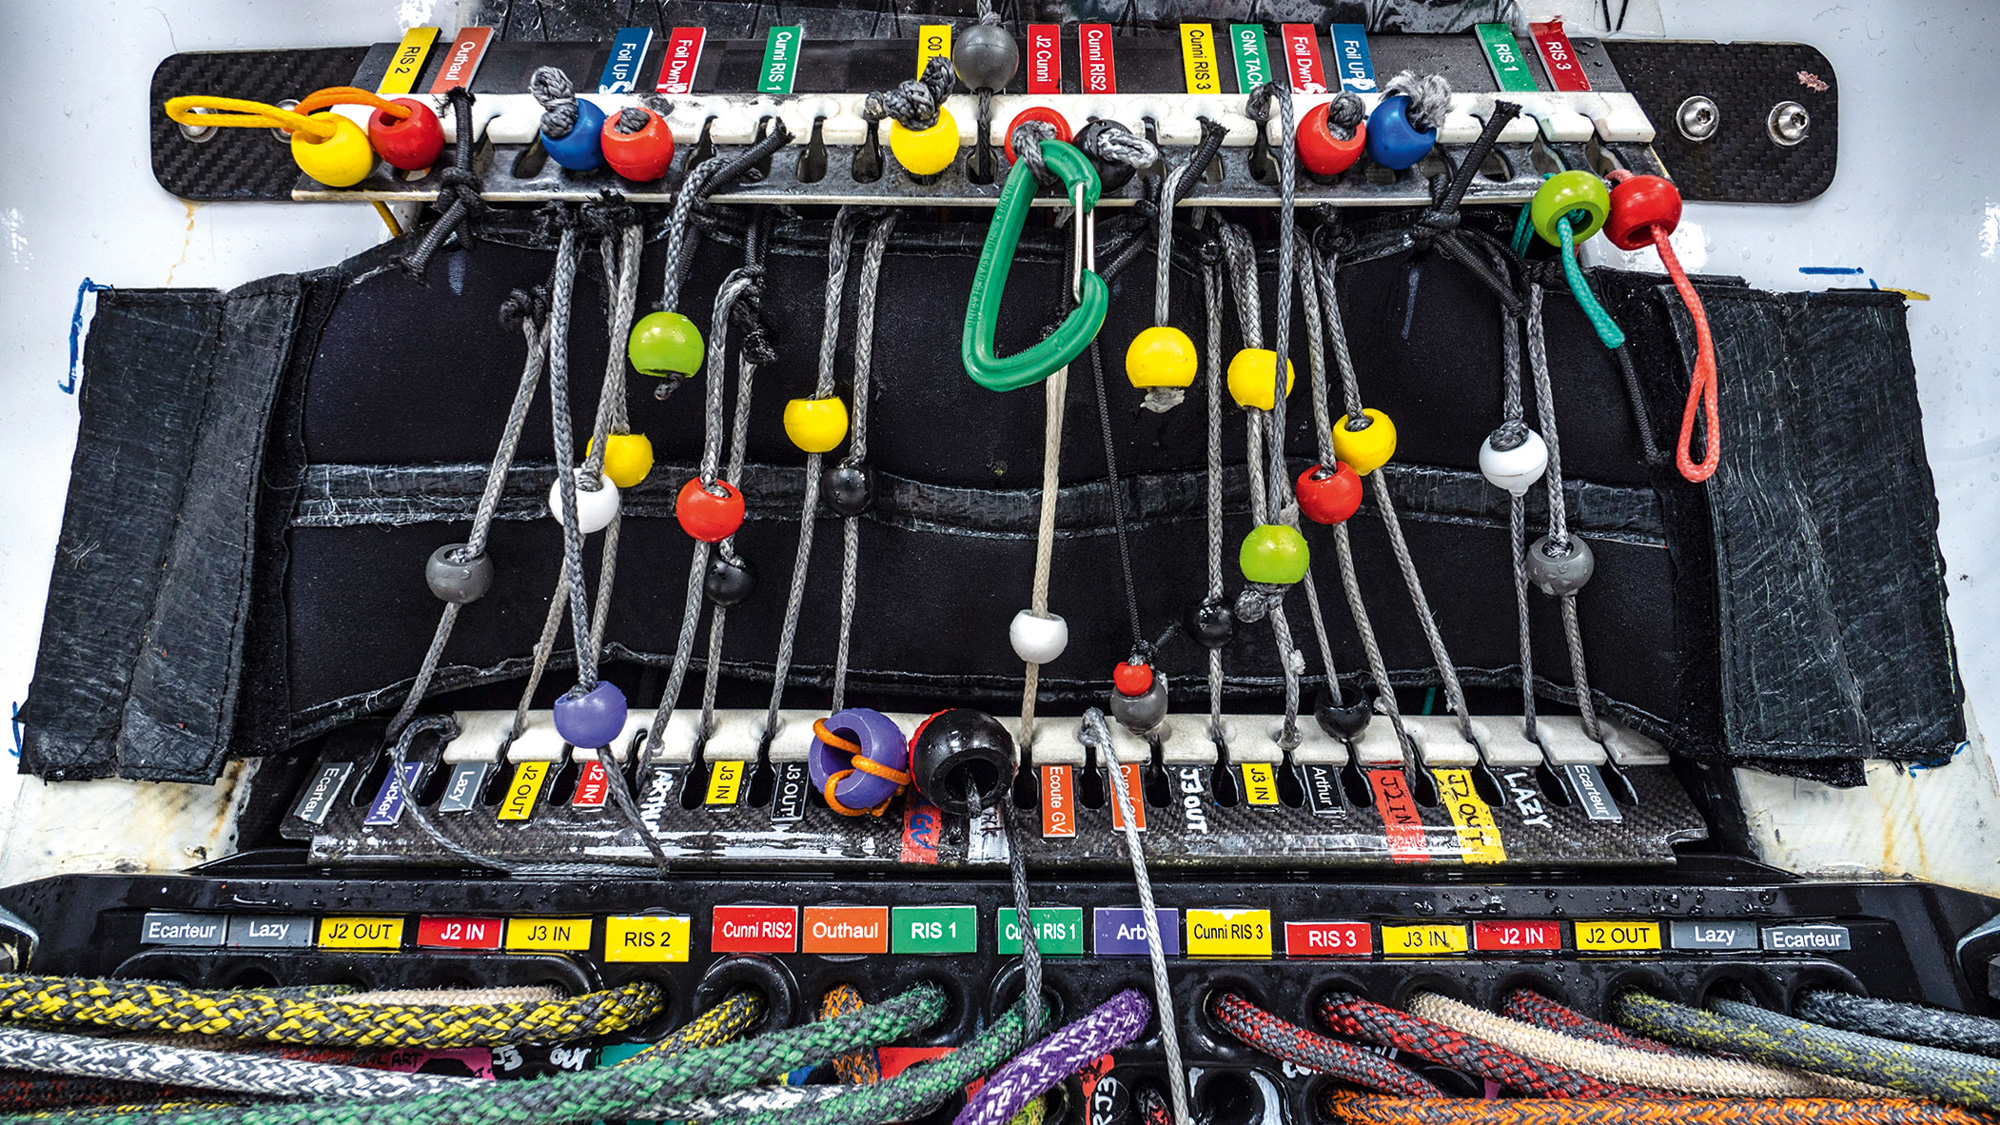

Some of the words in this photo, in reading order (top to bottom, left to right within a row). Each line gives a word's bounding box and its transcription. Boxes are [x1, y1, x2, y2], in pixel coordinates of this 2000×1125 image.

[674, 39, 693, 58] Foil
[774, 31, 793, 61] Cunni
[1036, 35, 1052, 48] J2
[1087, 29, 1105, 61] Cunni
[1189, 29, 1207, 59] Cunni
[1240, 29, 1259, 56] GNK
[1292, 36, 1309, 56] Foil
[1344, 40, 1361, 59] Foil
[400, 46, 421, 65] RIS
[617, 43, 637, 61] Foil
[1493, 43, 1515, 64] RIS
[1545, 41, 1568, 61] RIS
[445, 41, 476, 80] Outhaul
[1036, 50, 1053, 82] Cunni
[1555, 63, 1572, 71] 3
[612, 64, 629, 80] UP
[667, 60, 687, 84] Dwn
[768, 63, 787, 83] RIS
[1090, 63, 1107, 91] RIS2
[1194, 61, 1210, 81] RIS
[1245, 59, 1264, 90] TACK
[1296, 58, 1313, 83] Dwn
[1347, 62, 1366, 80] UP
[522, 765, 539, 780] J2
[588, 764, 605, 781] J2
[719, 765, 735, 781] J3
[786, 764, 802, 780] J3
[1250, 768, 1266, 783] J3
[448, 770, 475, 802] Lazy
[582, 784, 600, 799] IN
[715, 785, 731, 799] IN
[1049, 766, 1063, 809] Ecoute
[1254, 787, 1270, 801] IN
[1312, 766, 1332, 806] Arthur
[1573, 764, 1610, 816] Ecarteur
[509, 785, 532, 815] OUT
[780, 783, 799, 816] OUT
[1503, 772, 1552, 829] LAZY
[1051, 811, 1066, 833] GV
[148, 922, 217, 938] Ecarteur
[248, 921, 290, 940] Lazy
[328, 923, 348, 939] J2
[353, 923, 393, 940] OUT
[440, 923, 461, 940] J2
[465, 923, 485, 940] IN
[527, 925, 547, 941] J3
[553, 925, 571, 942] IN
[624, 931, 655, 947] RIS
[660, 931, 671, 947] 2
[723, 921, 759, 938] Cunni
[762, 921, 793, 939] RIS2
[812, 921, 879, 939] Outhaul
[911, 922, 943, 939] RIS
[948, 921, 956, 938] 1
[1005, 922, 1040, 940] Cui
[1043, 923, 1066, 940] RIS
[1069, 923, 1076, 939] 1
[1193, 924, 1228, 940] Cunni
[1231, 924, 1253, 940] RIS
[1255, 924, 1264, 940] 3
[1308, 930, 1340, 947] RIS
[1345, 930, 1357, 947] 3
[1403, 931, 1423, 947] J3
[1428, 930, 1447, 947] IN
[1500, 927, 1520, 944] J2
[1525, 927, 1544, 944] IN
[1585, 927, 1606, 943] J2
[1610, 927, 1650, 943] OUT
[1694, 925, 1735, 946] Lazy
[1772, 931, 1842, 948] Ecarteur
